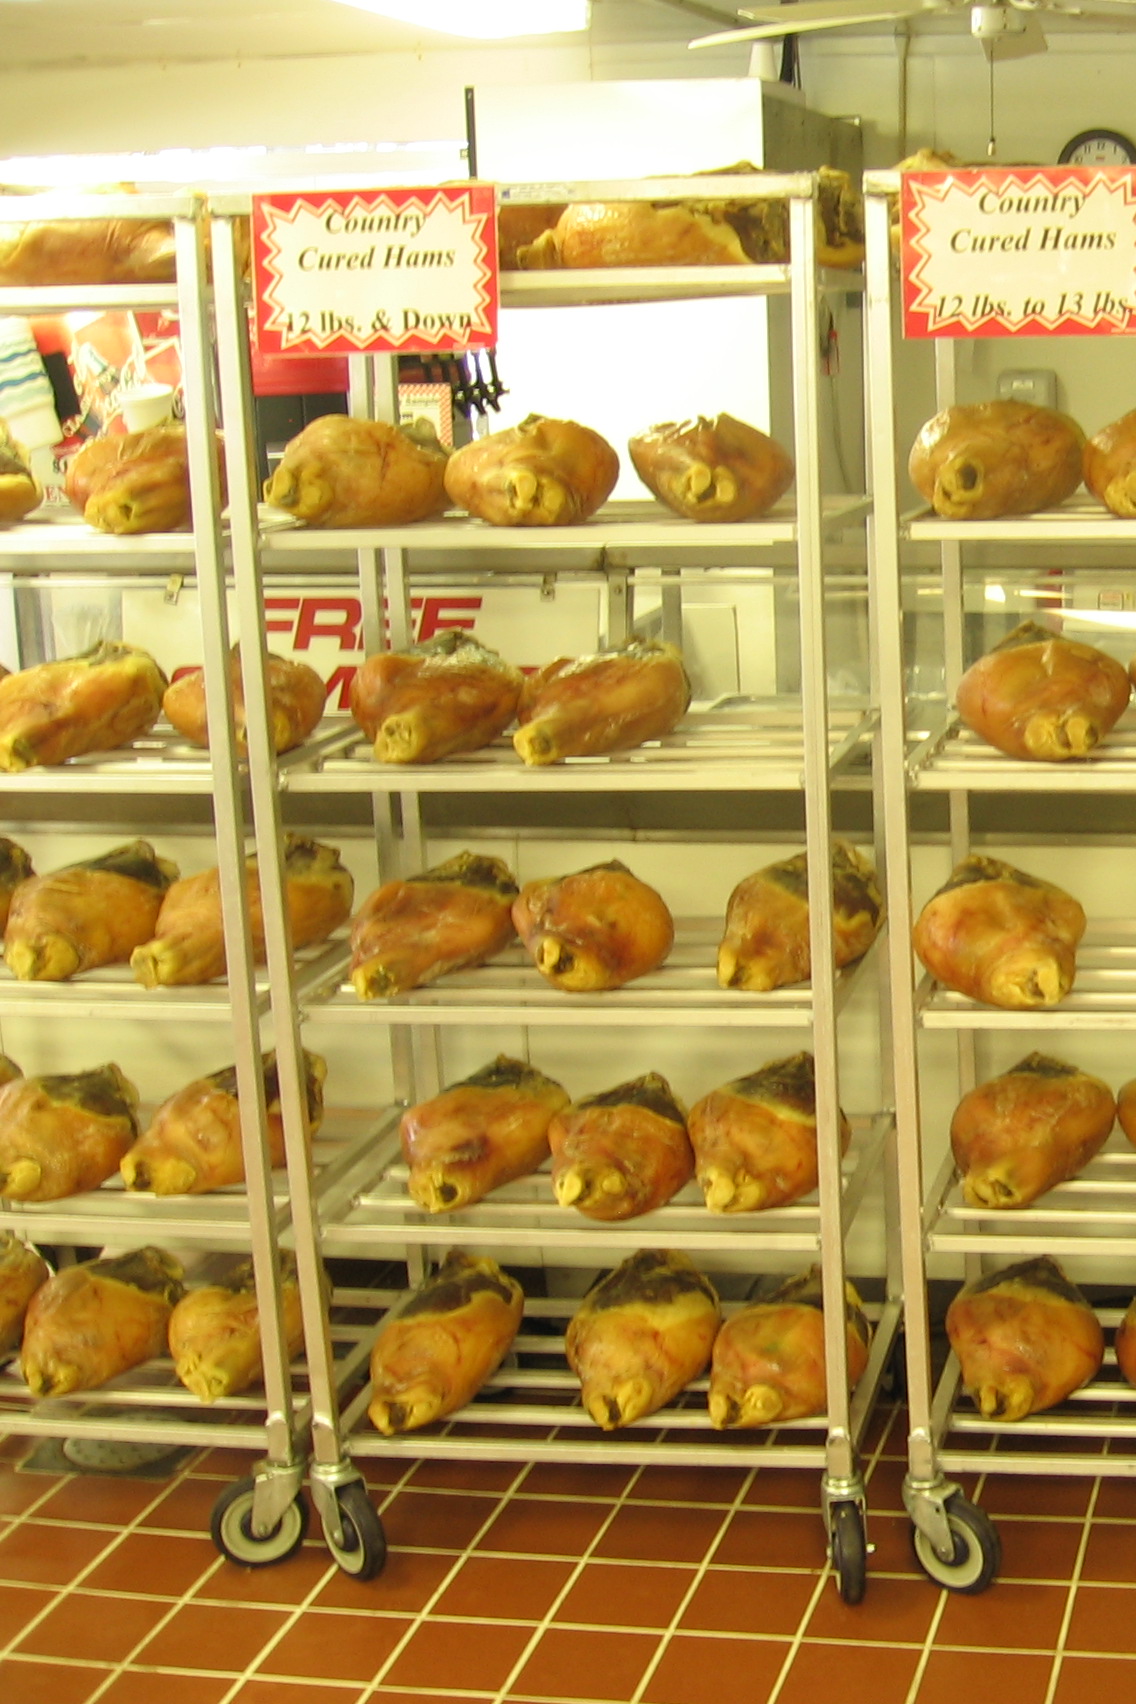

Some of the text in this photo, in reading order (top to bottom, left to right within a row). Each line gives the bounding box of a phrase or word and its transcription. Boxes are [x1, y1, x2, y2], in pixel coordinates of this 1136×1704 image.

[978, 190, 1086, 219] Country
[325, 209, 427, 238] Country
[950, 226, 1117, 253] Cured Hams
[298, 244, 456, 272] Cured Hams
[937, 294, 964, 318] 12
[971, 294, 1012, 317] lbs.
[1023, 296, 1046, 316] to
[1057, 292, 1083, 316] 13
[287, 308, 472, 334] 12 lbs. & Down
